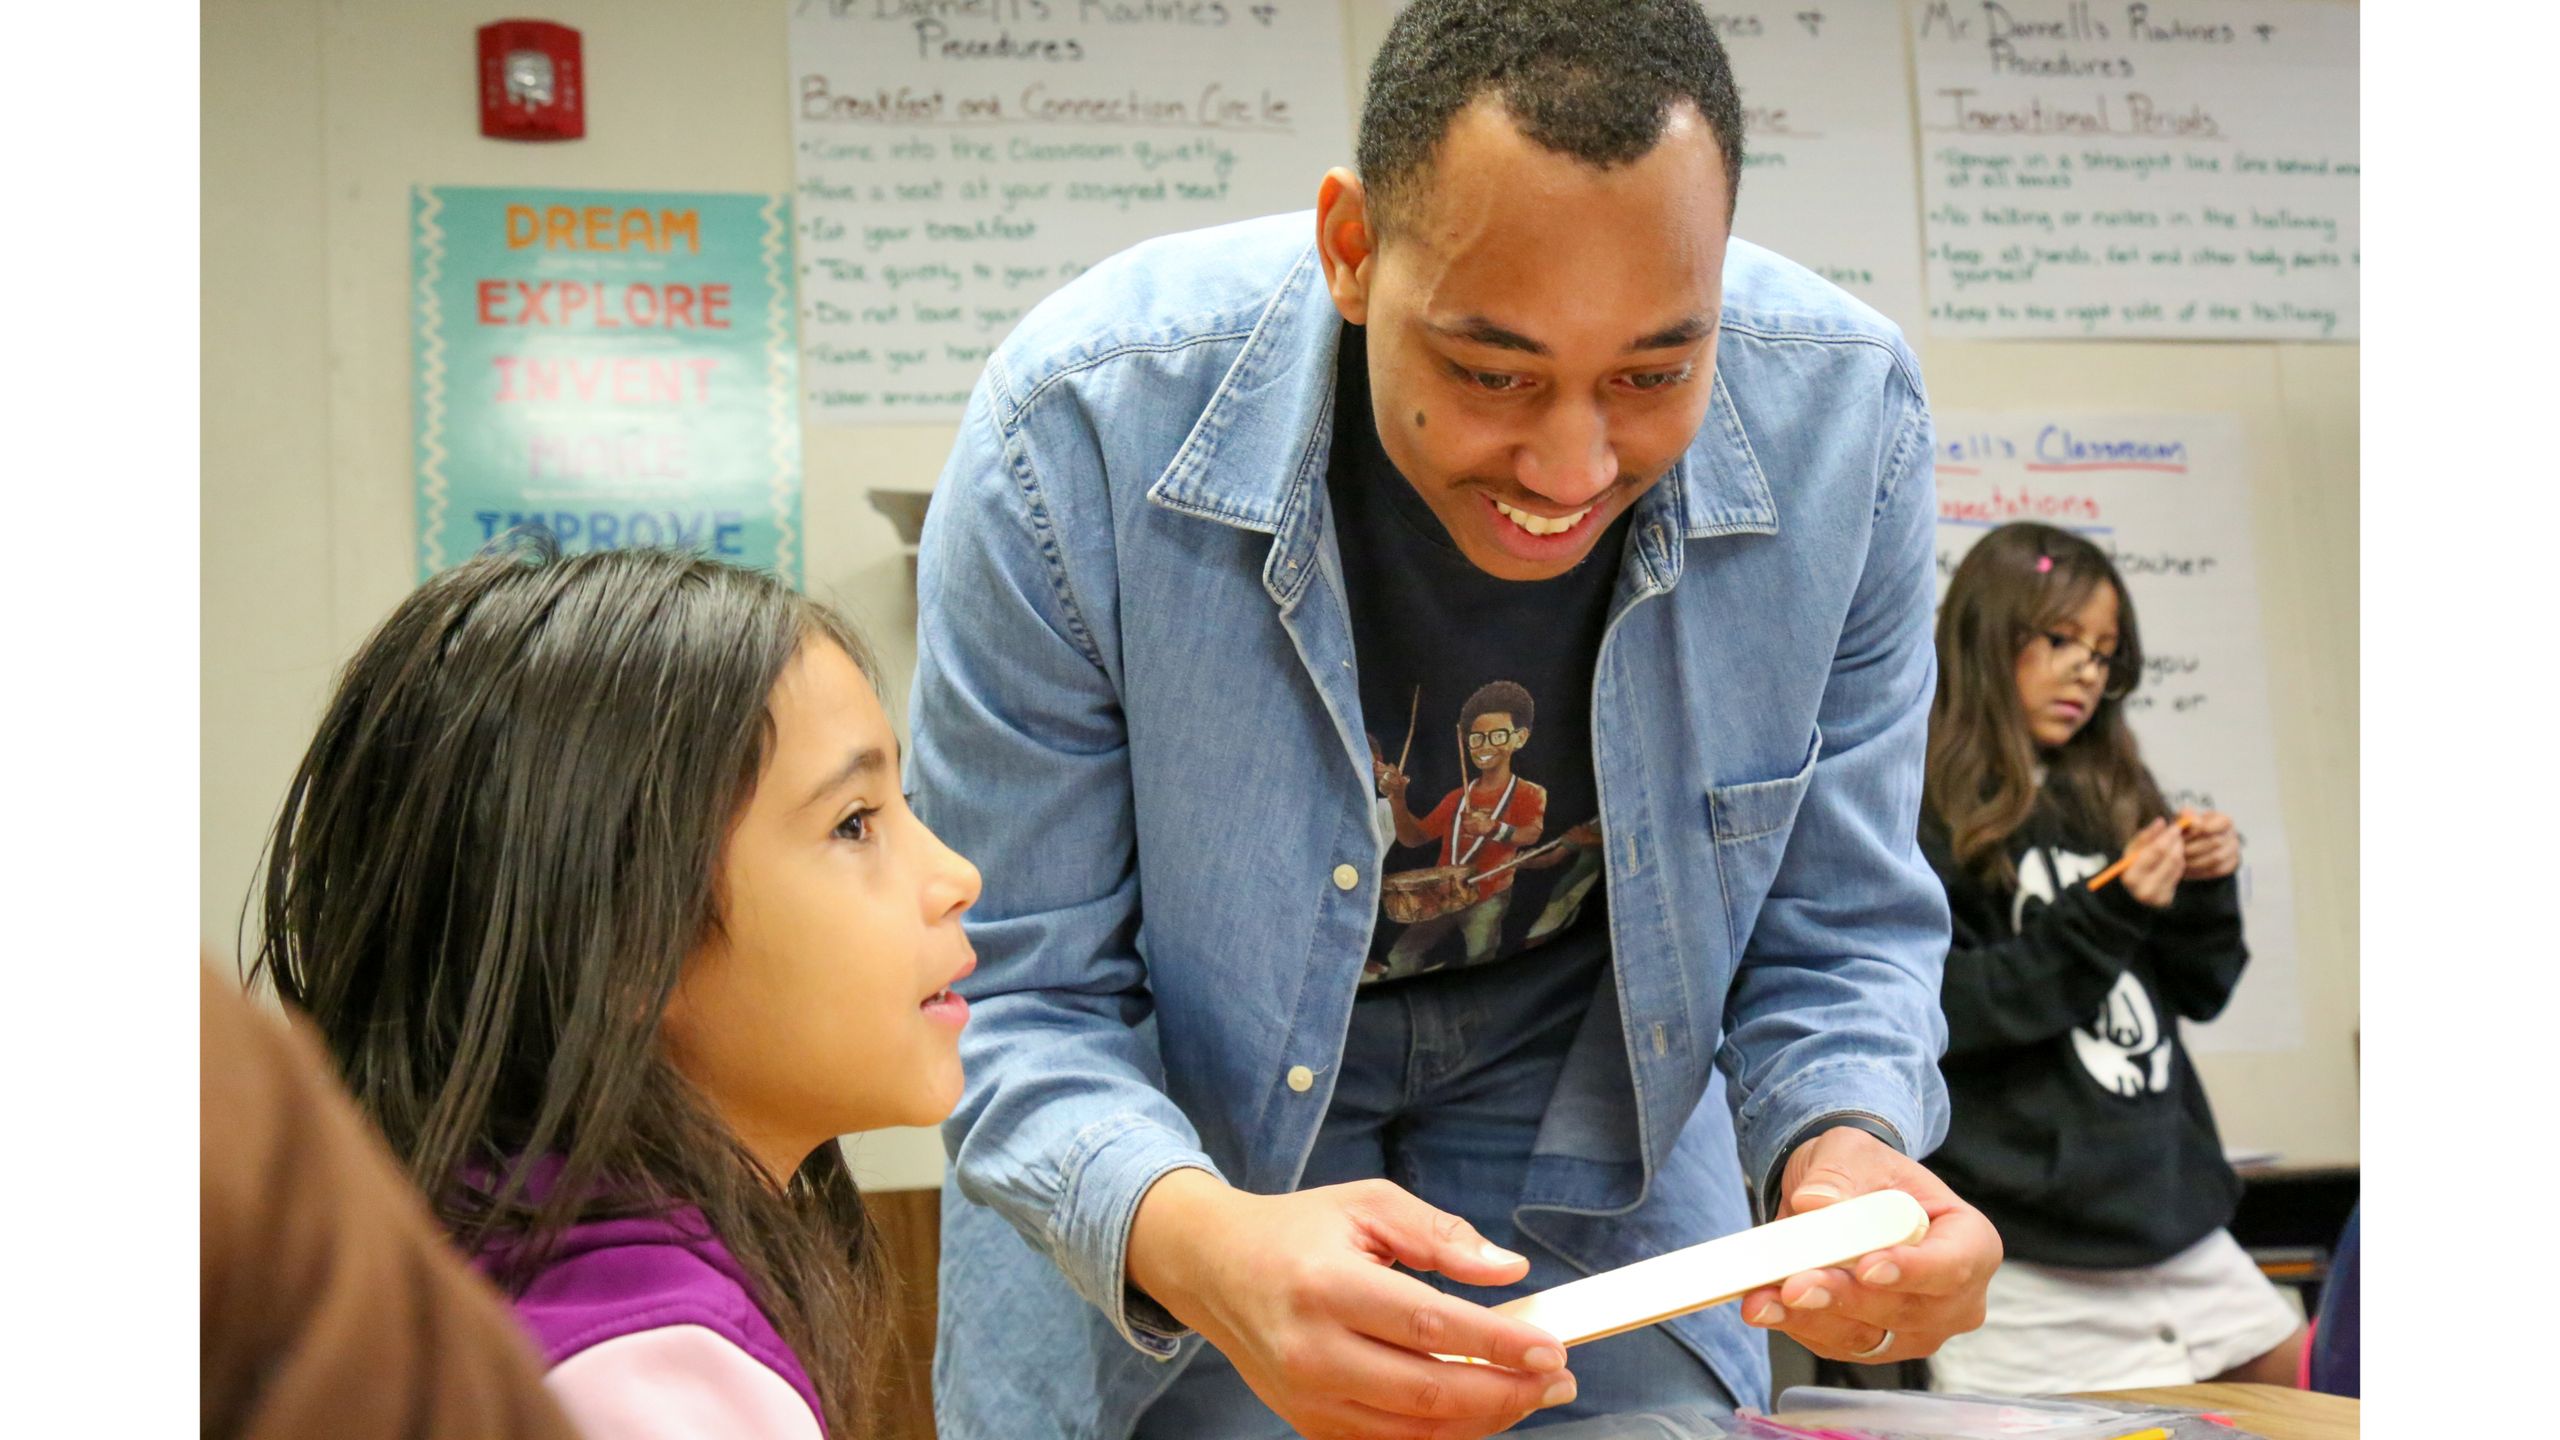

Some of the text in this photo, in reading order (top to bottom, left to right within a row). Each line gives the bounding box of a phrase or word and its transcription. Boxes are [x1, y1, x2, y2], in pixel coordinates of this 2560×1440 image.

[801, 74, 944, 121] Breakfast
[1020, 80, 1186, 122] Connection
[1198, 82, 1293, 126] Circle
[889, 134, 937, 160] into
[952, 133, 996, 161] the
[961, 176, 994, 200] at
[1002, 182, 1052, 212] your
[1176, 182, 1228, 200] seat
[504, 203, 701, 255] DREAM
[863, 225, 912, 252] your
[925, 214, 1037, 242] breakfast
[1982, 206, 2056, 235] talking
[2204, 204, 2240, 230] the
[2250, 205, 2338, 245] hallway
[882, 261, 962, 293] quietly
[1003, 265, 1047, 289] your
[1951, 259, 2039, 292] yourself
[2150, 245, 2182, 266] and
[2195, 244, 2238, 267] other
[2247, 245, 2288, 277] body
[475, 279, 733, 330] EXPLORE
[815, 300, 852, 322] Do
[862, 303, 900, 323] not
[2024, 303, 2057, 323] the
[2066, 302, 2112, 334] right
[2121, 300, 2164, 325] side
[2178, 300, 2197, 324] of
[2208, 302, 2242, 324] the
[2252, 300, 2338, 338] hallway
[491, 356, 720, 407] INVENT
[528, 434, 688, 480] MAKE
[2036, 424, 2187, 464] Classroom
